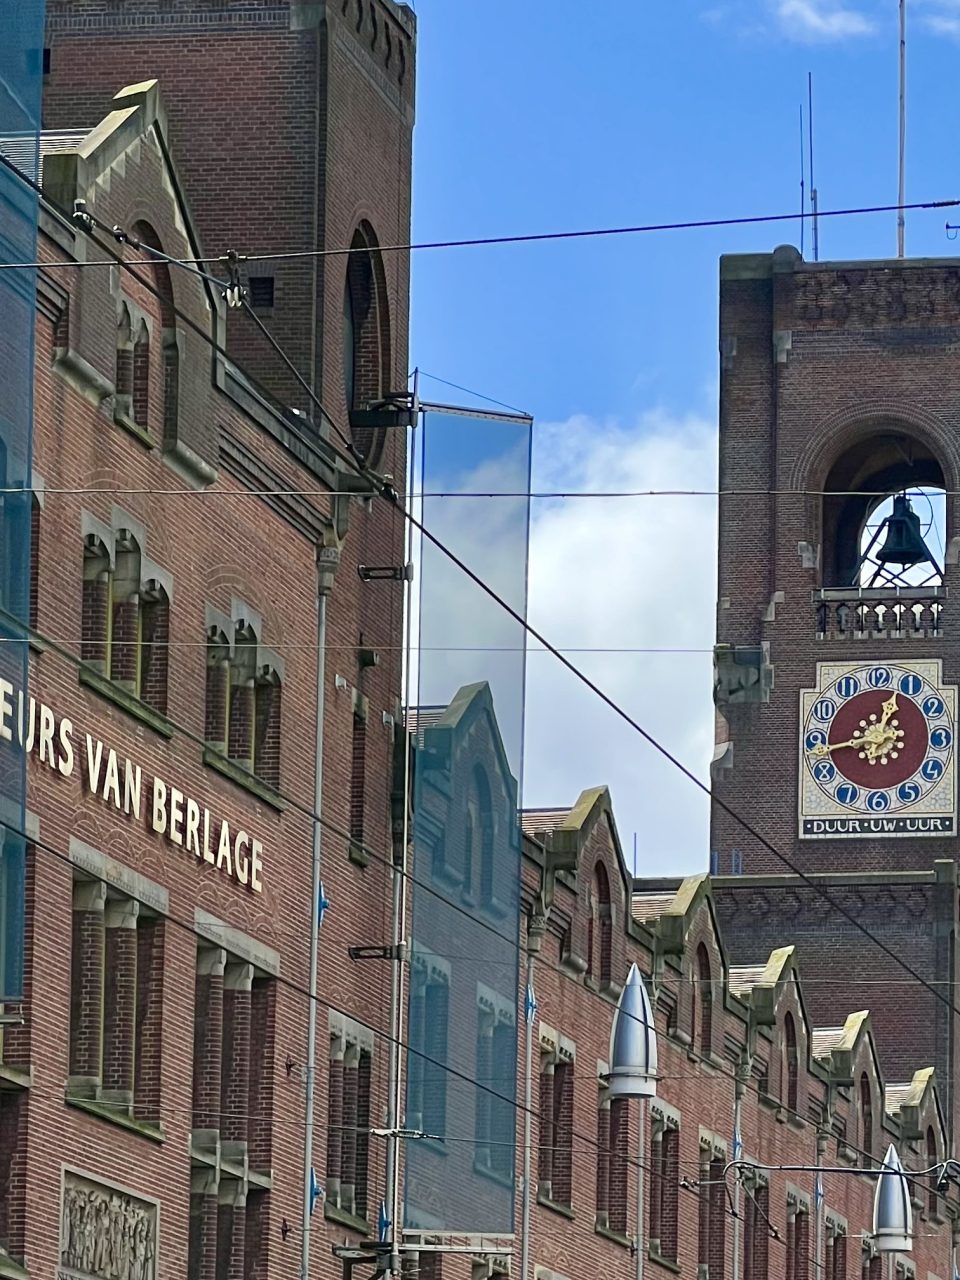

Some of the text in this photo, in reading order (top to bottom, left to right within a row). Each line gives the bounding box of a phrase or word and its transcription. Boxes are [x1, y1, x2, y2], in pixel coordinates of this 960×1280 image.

[841, 677, 855, 695] 11
[871, 668, 888, 686] 12
[907, 676, 914, 694] 1
[816, 701, 833, 719] 10
[928, 697, 939, 716] 2
[935, 730, 946, 749] 3
[819, 761, 830, 781] 8
[927, 762, 938, 782] 4
[842, 785, 853, 803] 7
[873, 791, 885, 810] 6
[905, 782, 916, 801] 5
[86, 733, 142, 820] VAN
[152, 776, 263, 893] BERLAGE
[813, 818, 943, 833] DUUR UW UUR
